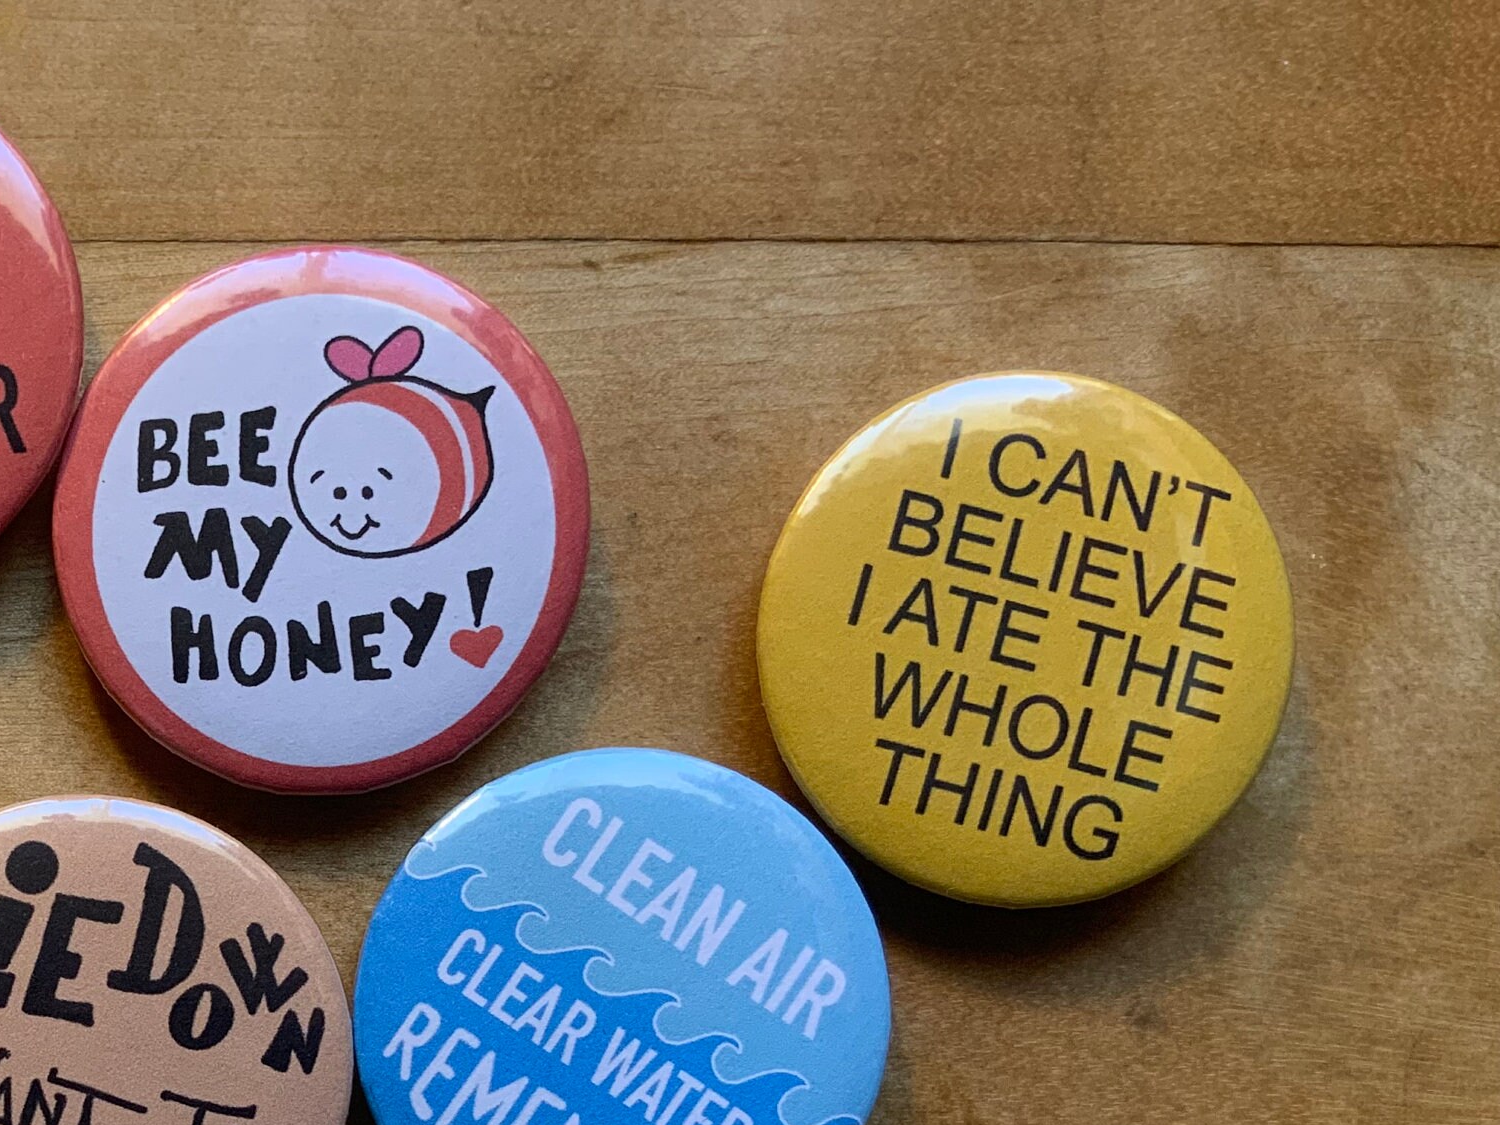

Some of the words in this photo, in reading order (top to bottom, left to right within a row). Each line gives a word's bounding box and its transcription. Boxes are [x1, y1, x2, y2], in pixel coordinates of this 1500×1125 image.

[136, 404, 278, 494] BEE
[939, 416, 963, 480] I
[143, 507, 293, 604] MY
[886, 488, 1237, 640] BELIEVE
[169, 566, 500, 688] HONEY!
[846, 562, 874, 627] I
[881, 577, 1050, 673] ATE
[1075, 619, 1234, 724] THE
[873, 651, 1174, 793] WHOLE
[873, 737, 1124, 862] THING
[540, 797, 747, 969] CLEAN
[724, 927, 848, 1041] AIR
[435, 928, 598, 1066] CLEAR
